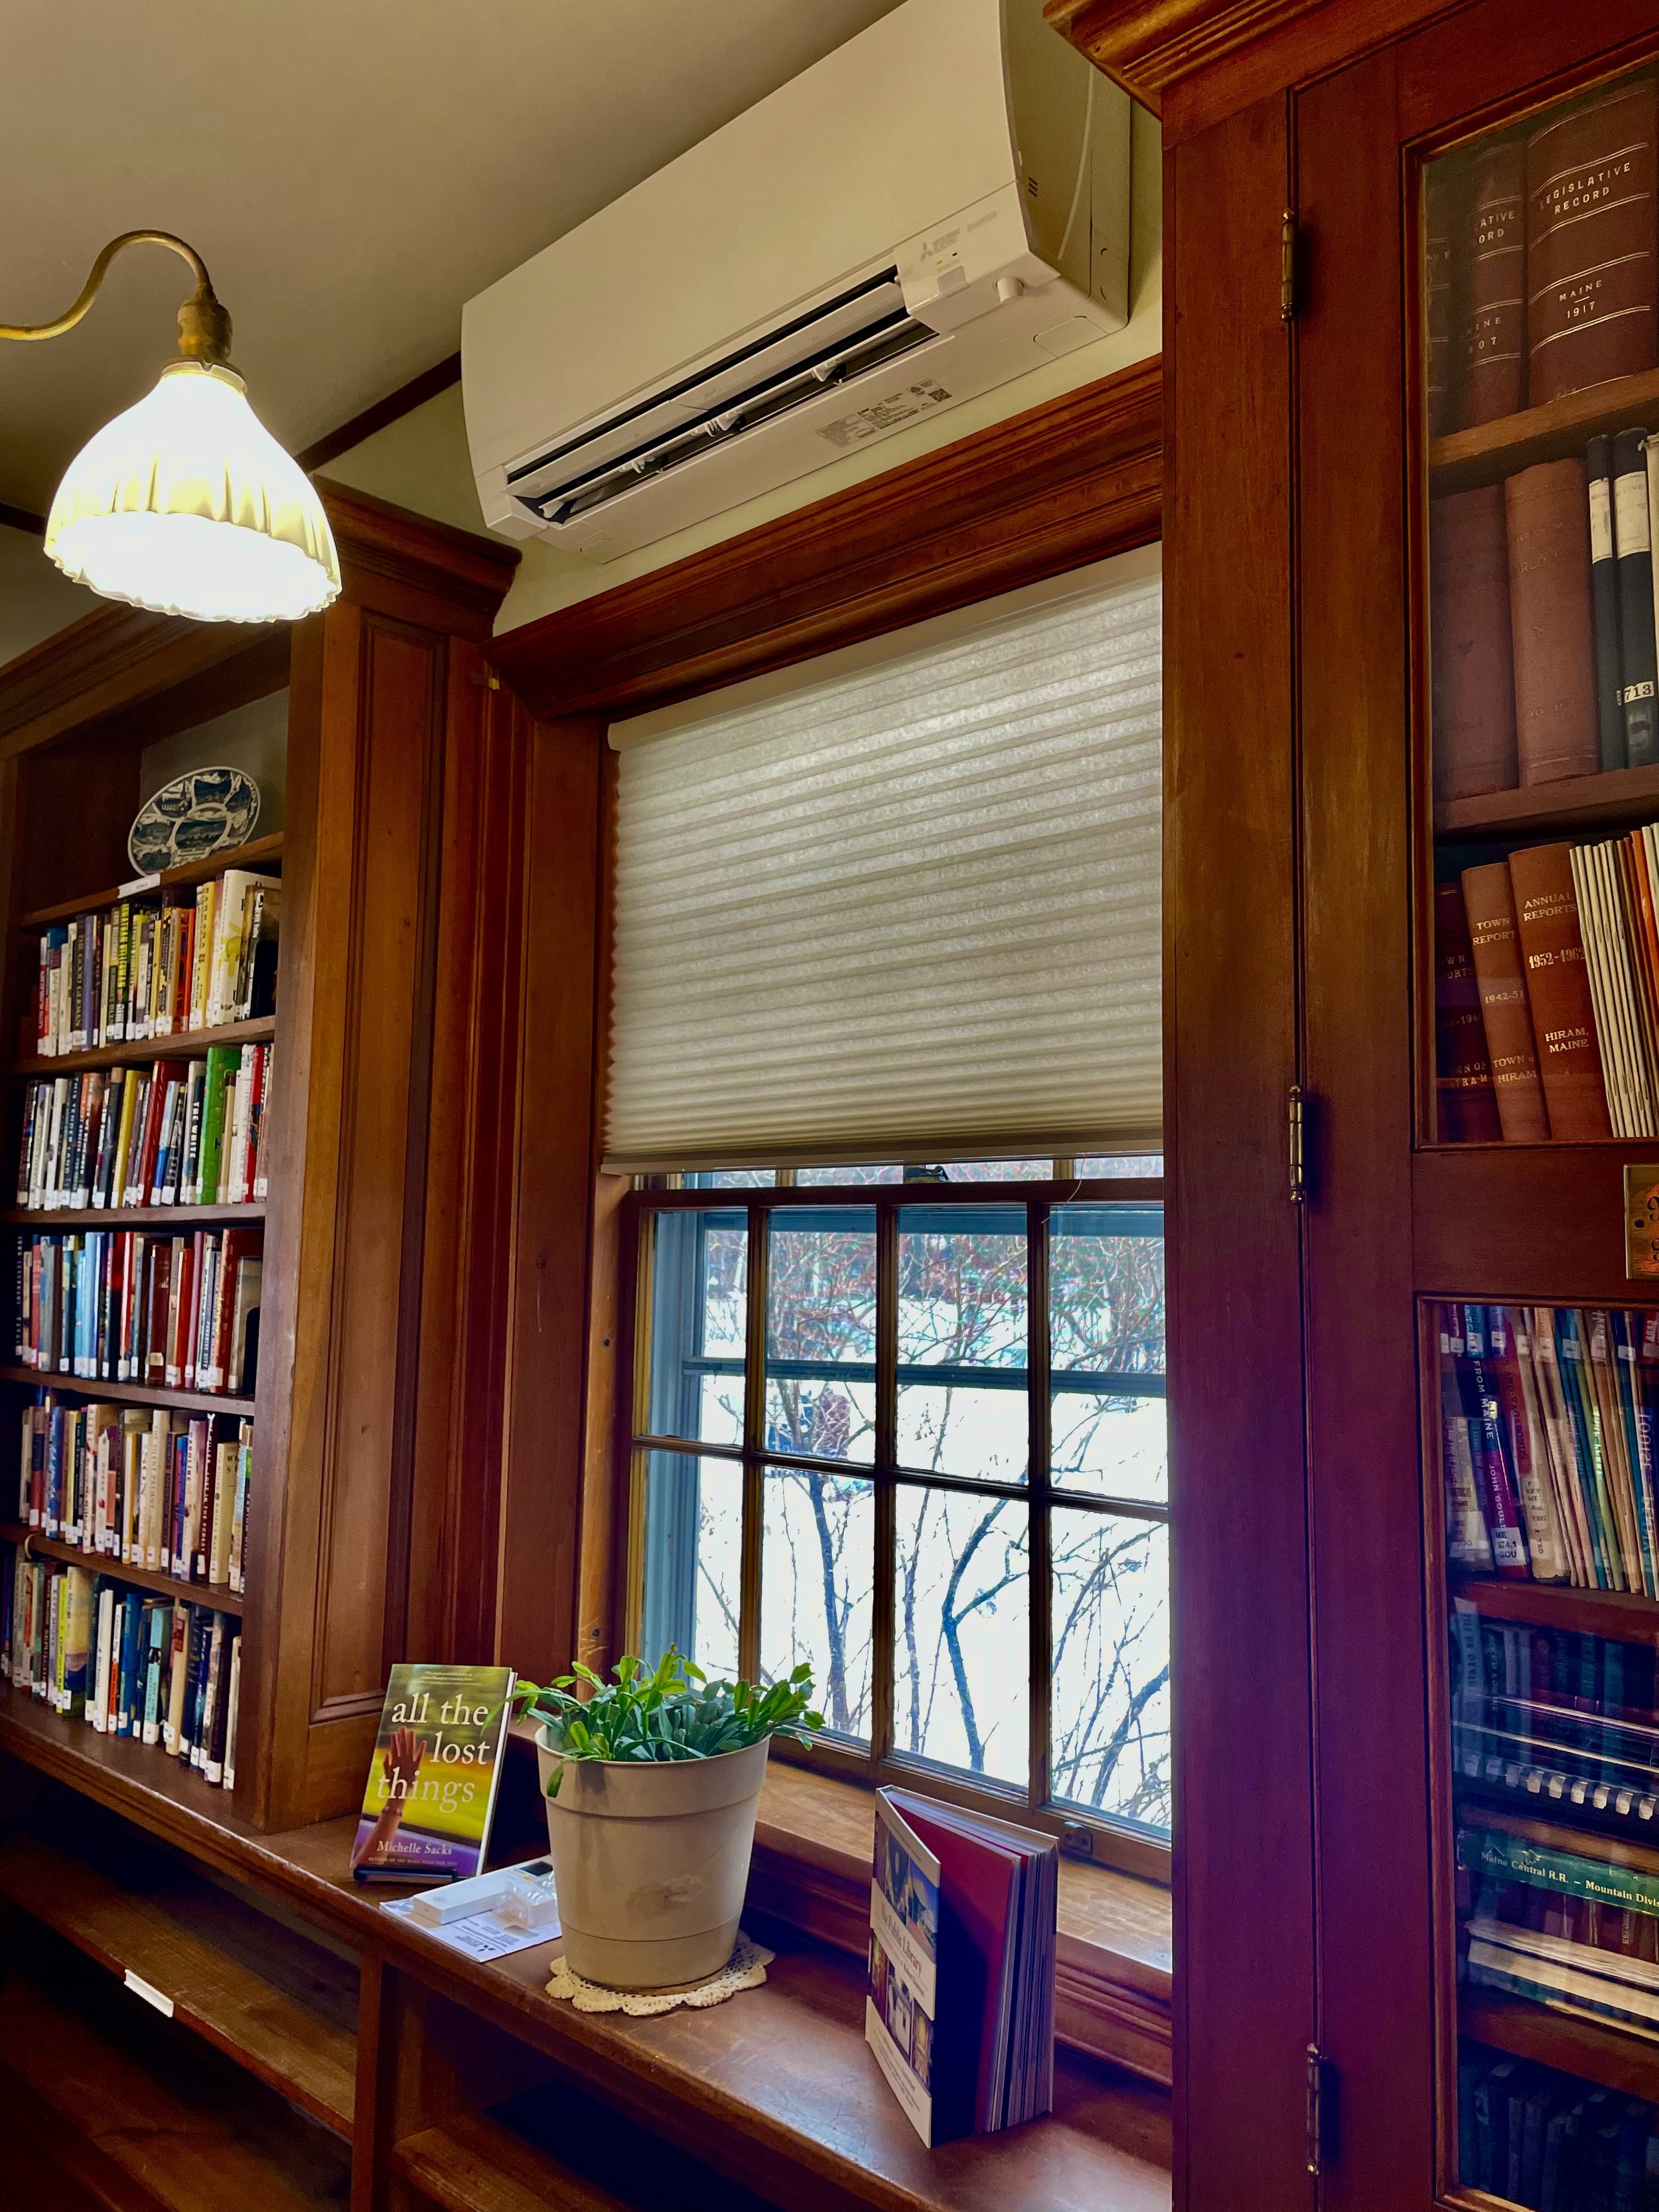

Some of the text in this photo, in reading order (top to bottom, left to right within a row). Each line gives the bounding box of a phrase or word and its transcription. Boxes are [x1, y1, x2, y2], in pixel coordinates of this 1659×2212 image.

[1540, 162, 1631, 210] LEGISLATIVE
[1554, 186, 1610, 214] RECORD
[1559, 279, 1603, 301] MAINE
[1567, 301, 1595, 319] 1917
[1624, 684, 1652, 701] 713
[1524, 891, 1573, 909] ANNUAL
[1476, 917, 1510, 930] TOWN
[1522, 903, 1577, 922] REPORTS
[1528, 946, 1587, 970] 1952-1962
[1548, 1039, 1590, 1054] MAINE
[1493, 1055, 1525, 1069] TOWN
[1498, 1070, 1538, 1083] HIRAM
[189, 1124, 198, 1159] WHITE
[1473, 1360, 1485, 1393] FROM
[1479, 1398, 1494, 1440] MAINE
[1488, 1465, 1500, 1492] JOHN
[390, 1692, 488, 1726] all the
[429, 1730, 490, 1765] lost
[376, 1766, 476, 1814] things
[376, 1840, 453, 1856] Michelle Sacks
[1480, 1851, 1508, 1866] Maine
[1511, 1860, 1546, 1878] Central
[1548, 1870, 1569, 1883] R.R.
[1585, 1880, 1632, 1901] Mountain
[888, 1914, 902, 1949] Public
[902, 1935, 923, 1980] Library
